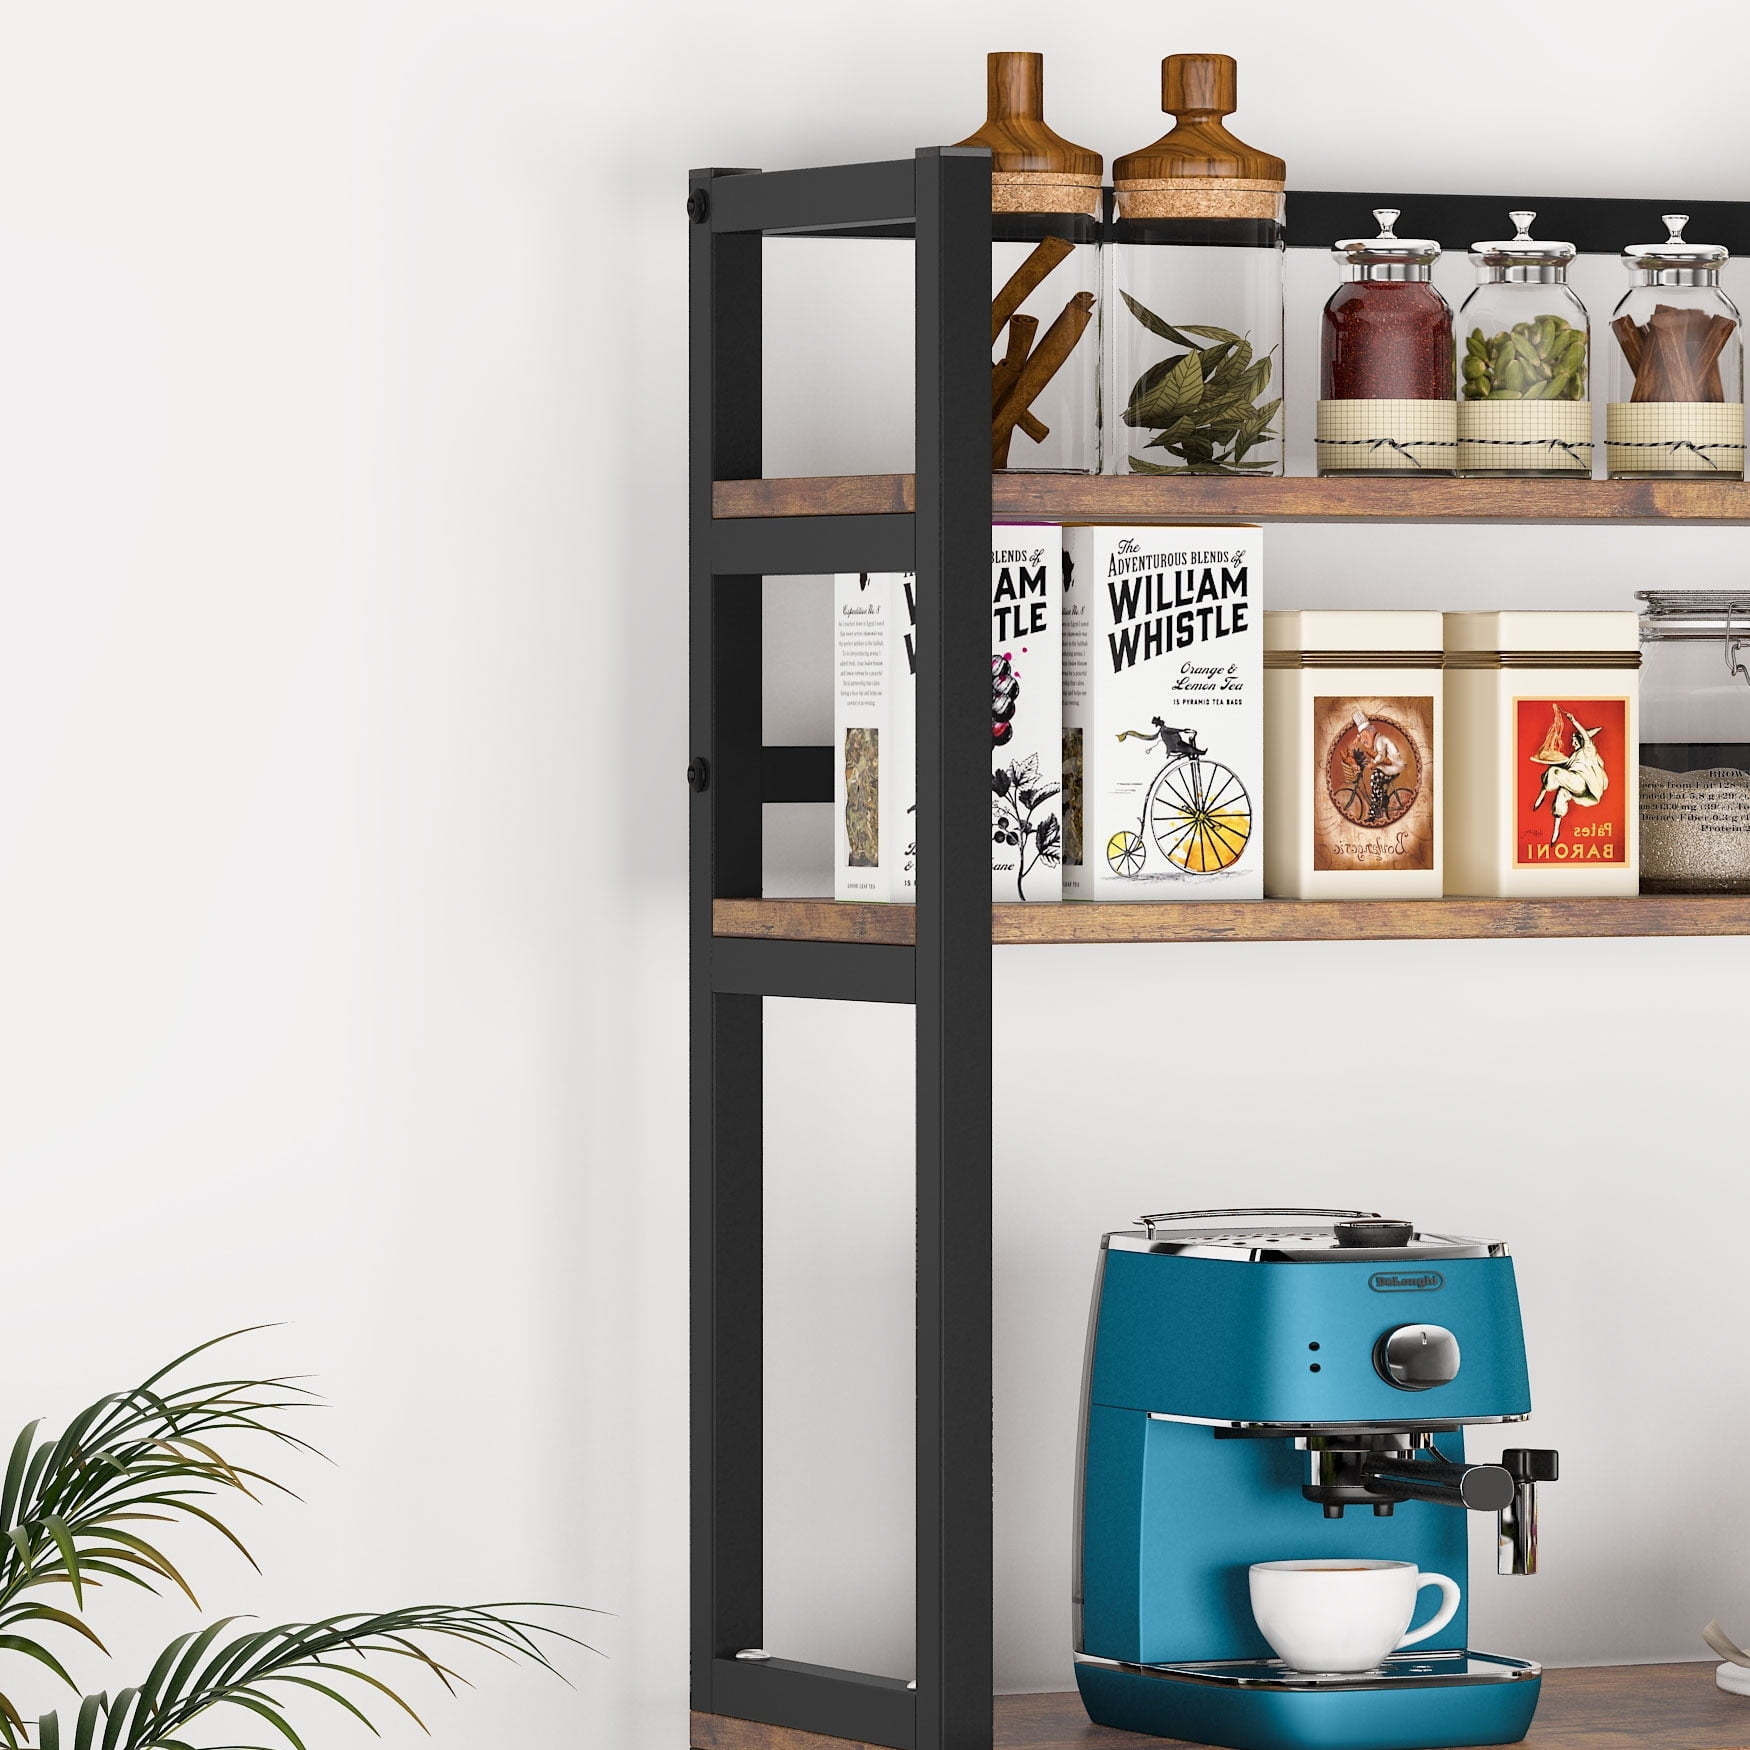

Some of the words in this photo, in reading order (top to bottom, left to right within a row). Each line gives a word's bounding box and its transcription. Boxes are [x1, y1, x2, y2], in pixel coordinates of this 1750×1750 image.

[1117, 537, 1142, 555] The
[1029, 548, 1045, 567] of
[1107, 552, 1188, 578] ADVENTUROUS
[1190, 551, 1229, 565] BLENDS
[1231, 549, 1246, 568] of
[1107, 566, 1249, 625] WILLIAM
[1107, 602, 1249, 674] WHISTLE
[1180, 660, 1225, 679] Orange
[1227, 663, 1238, 674] &
[1171, 676, 1216, 691] Lemon
[1220, 676, 1243, 691] Tea
